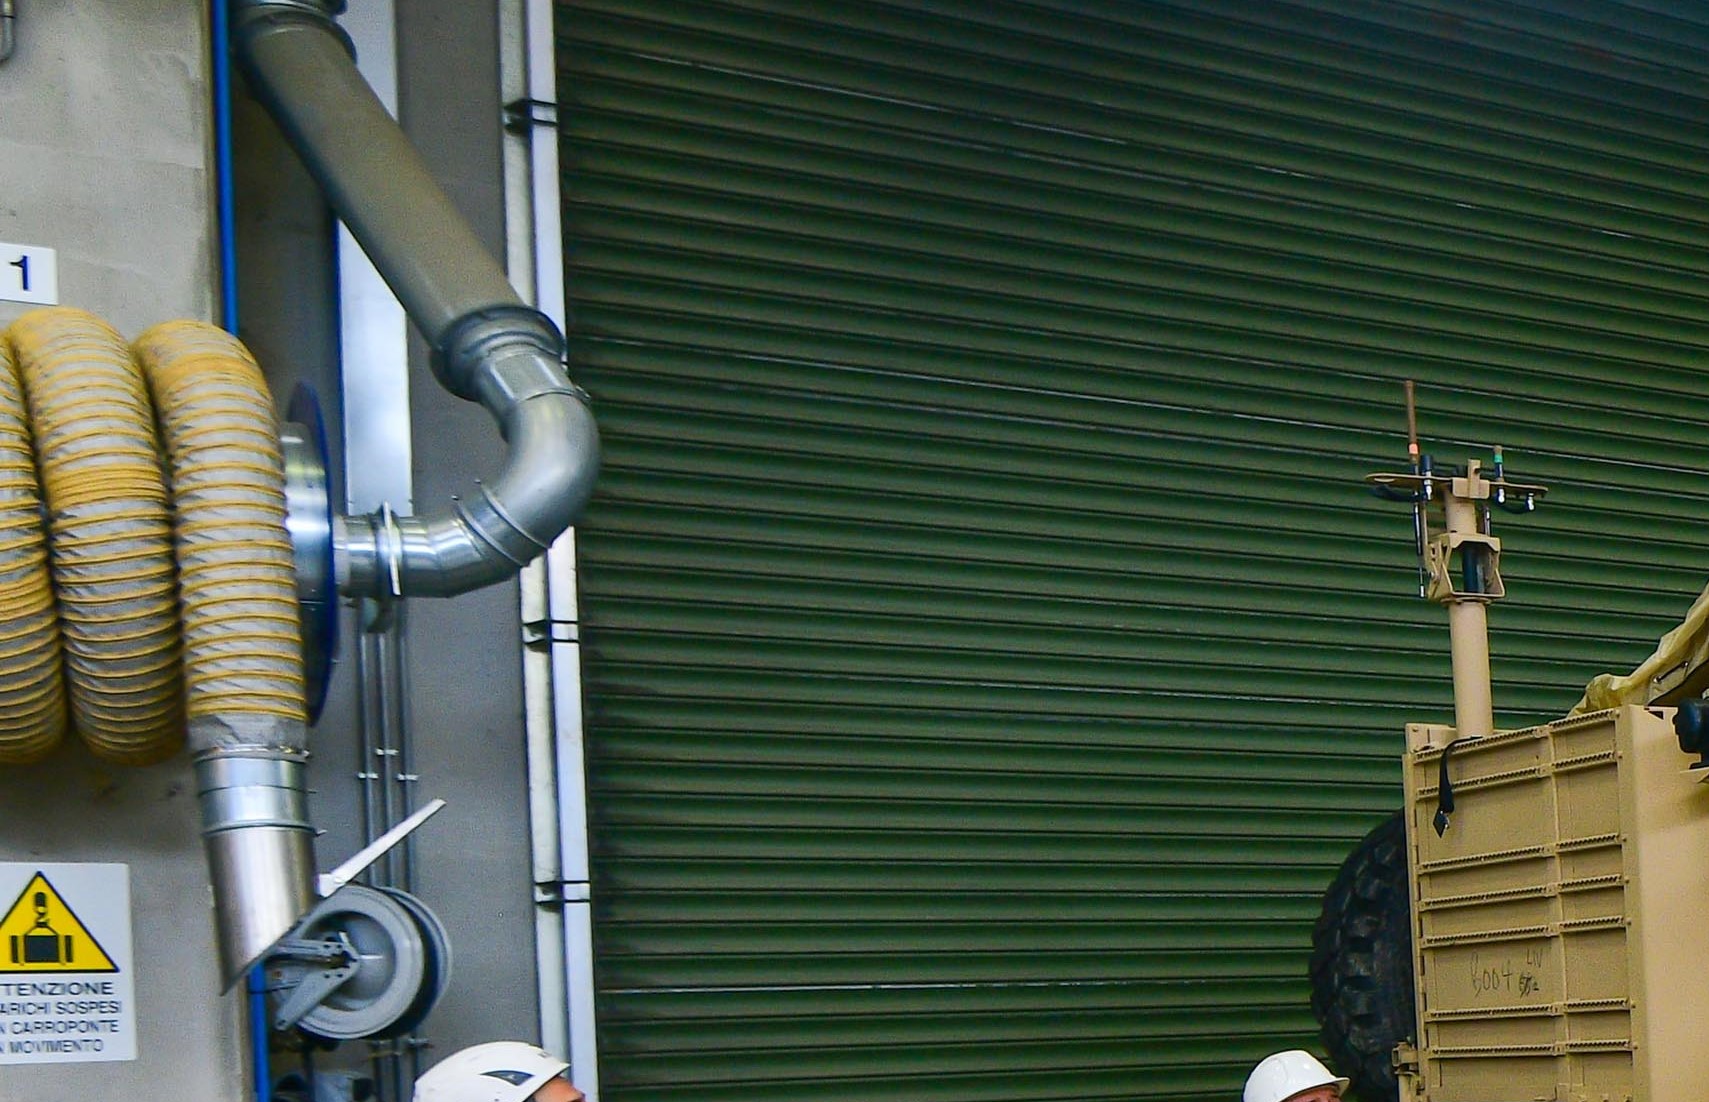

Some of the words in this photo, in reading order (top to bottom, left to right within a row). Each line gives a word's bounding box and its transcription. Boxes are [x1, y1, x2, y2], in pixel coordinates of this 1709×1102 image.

[56, 1001, 122, 1015] SOSPESI
[11, 1020, 120, 1034] CARROPONTE
[9, 1039, 104, 1053] MOVIMENTO
